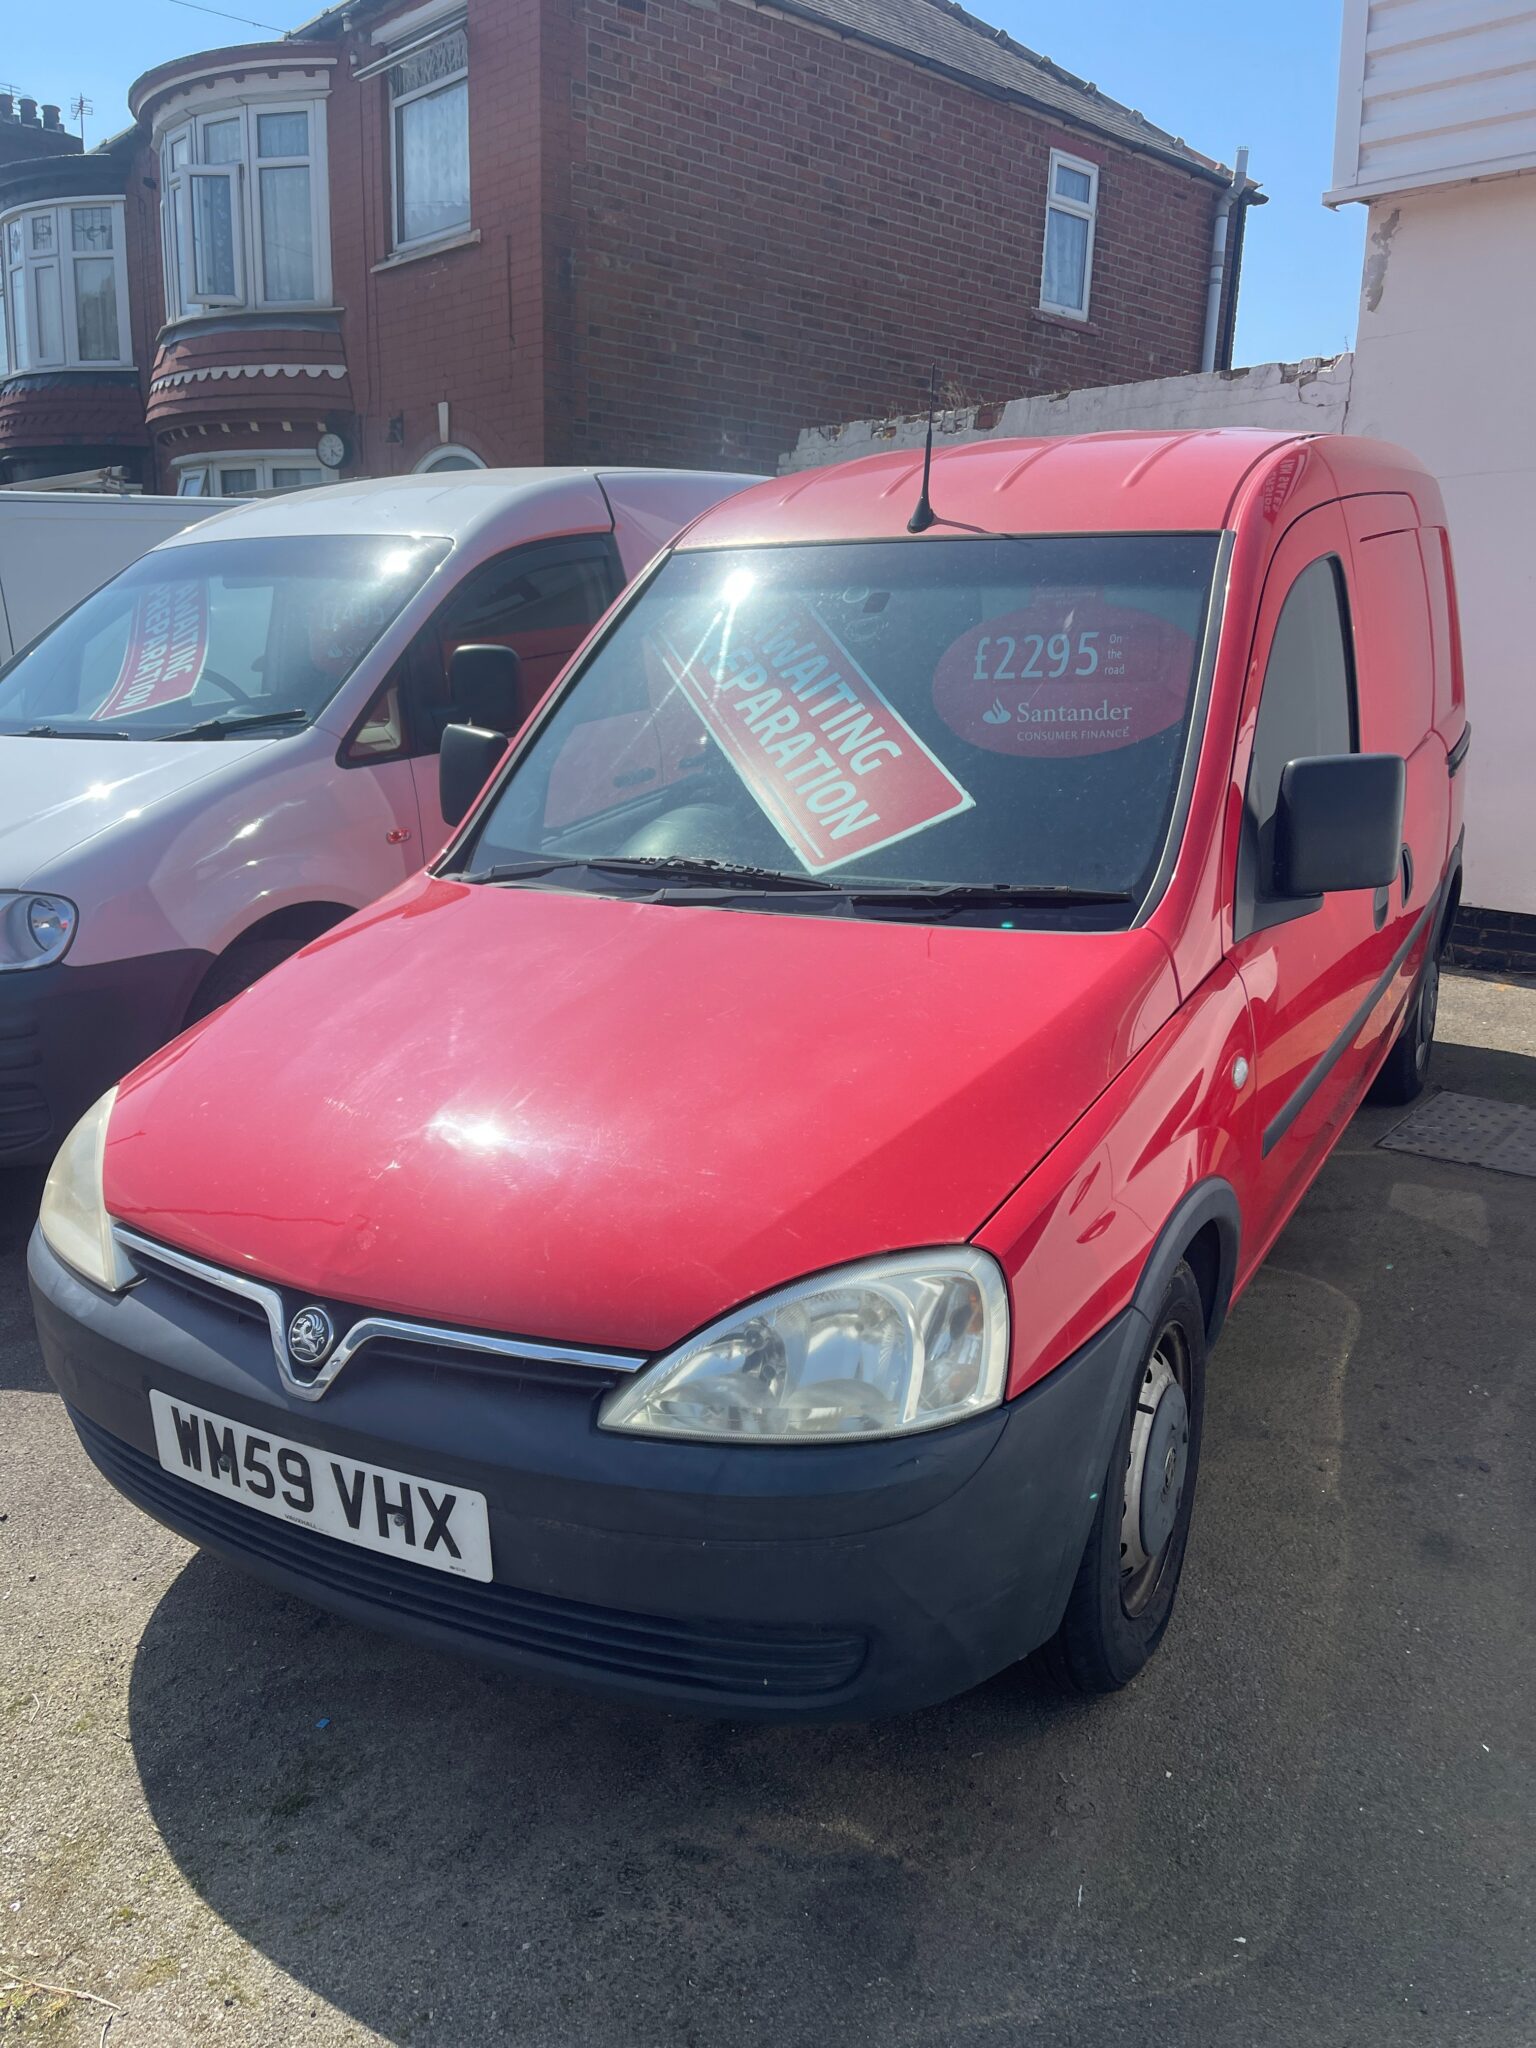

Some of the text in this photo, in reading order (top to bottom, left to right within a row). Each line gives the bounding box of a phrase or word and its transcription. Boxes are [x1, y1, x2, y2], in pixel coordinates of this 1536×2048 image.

[161, 583, 199, 682] AWAITING
[1109, 633, 1122, 644] On
[115, 582, 171, 711] PREPARATION
[973, 631, 1100, 681] £2295
[1107, 649, 1122, 660] the
[1104, 664, 1125, 676] road
[1016, 699, 1133, 723] Santander
[1016, 728, 1130, 742] CONSUMER FINANCE
[171, 1406, 462, 1560] WM59 VHX
